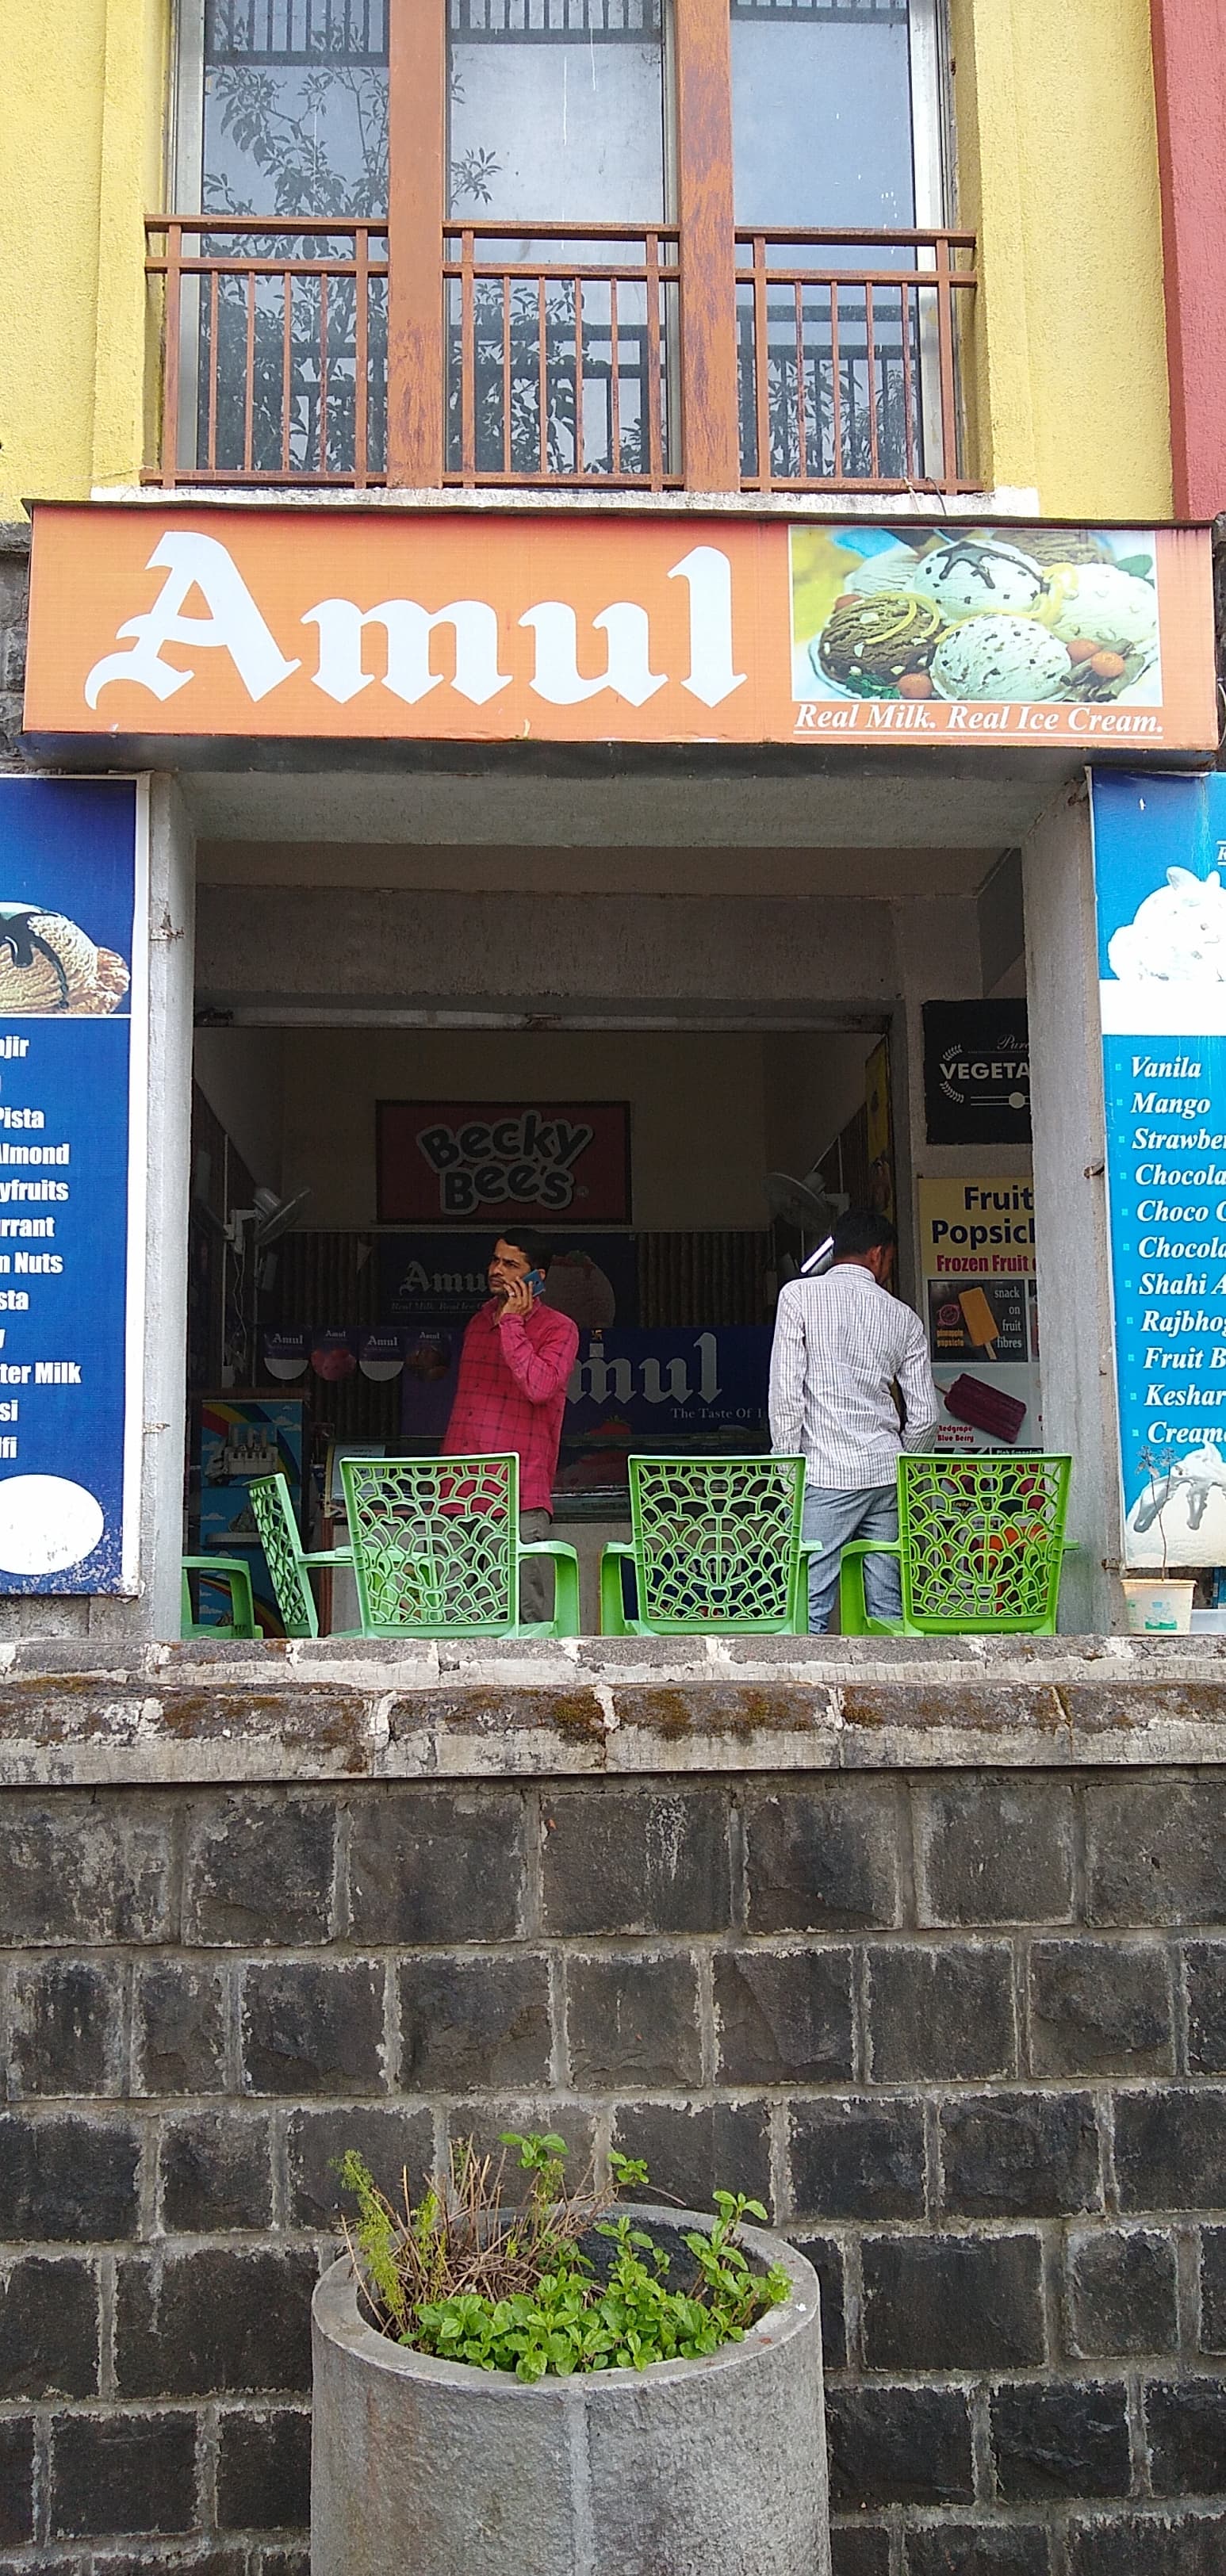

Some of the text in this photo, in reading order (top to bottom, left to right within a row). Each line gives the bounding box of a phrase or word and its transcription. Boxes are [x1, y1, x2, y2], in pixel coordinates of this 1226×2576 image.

[84, 530, 748, 710] Amul
[794, 703, 1163, 733] Real Milk. Real Ice Cream.
[939, 1062, 1029, 1079] VEGETA
[1131, 1056, 1201, 1078] Vanila
[1129, 1092, 1211, 1120] Mango
[417, 1112, 592, 1171] Becky
[0, 1143, 70, 1165] lmond
[442, 1162, 573, 1213] Bee's
[964, 1185, 1034, 1211] Fruit
[1136, 1200, 1209, 1223] Choco
[0, 1215, 56, 1238] rrant
[14, 1251, 63, 1274] Nuts
[936, 1255, 989, 1272] Frozen
[992, 1254, 1029, 1272] Fruit
[399, 1260, 489, 1296] Amu
[1138, 1272, 1207, 1296] Shahi
[994, 1286, 1021, 1298] snack
[1009, 1306, 1021, 1315] on
[1002, 1319, 1022, 1331] fruit
[272, 1333, 304, 1345] Amul
[367, 1334, 397, 1346] Amul
[565, 1332, 722, 1404] mul
[1143, 1347, 1208, 1370] Fruit
[35, 1361, 82, 1384] Milk
[1144, 1384, 1226, 1407] Keshar
[670, 1407, 695, 1418] The
[699, 1407, 733, 1418] Taste
[736, 1407, 753, 1418] Of
[1147, 1420, 1226, 1445] Cream
